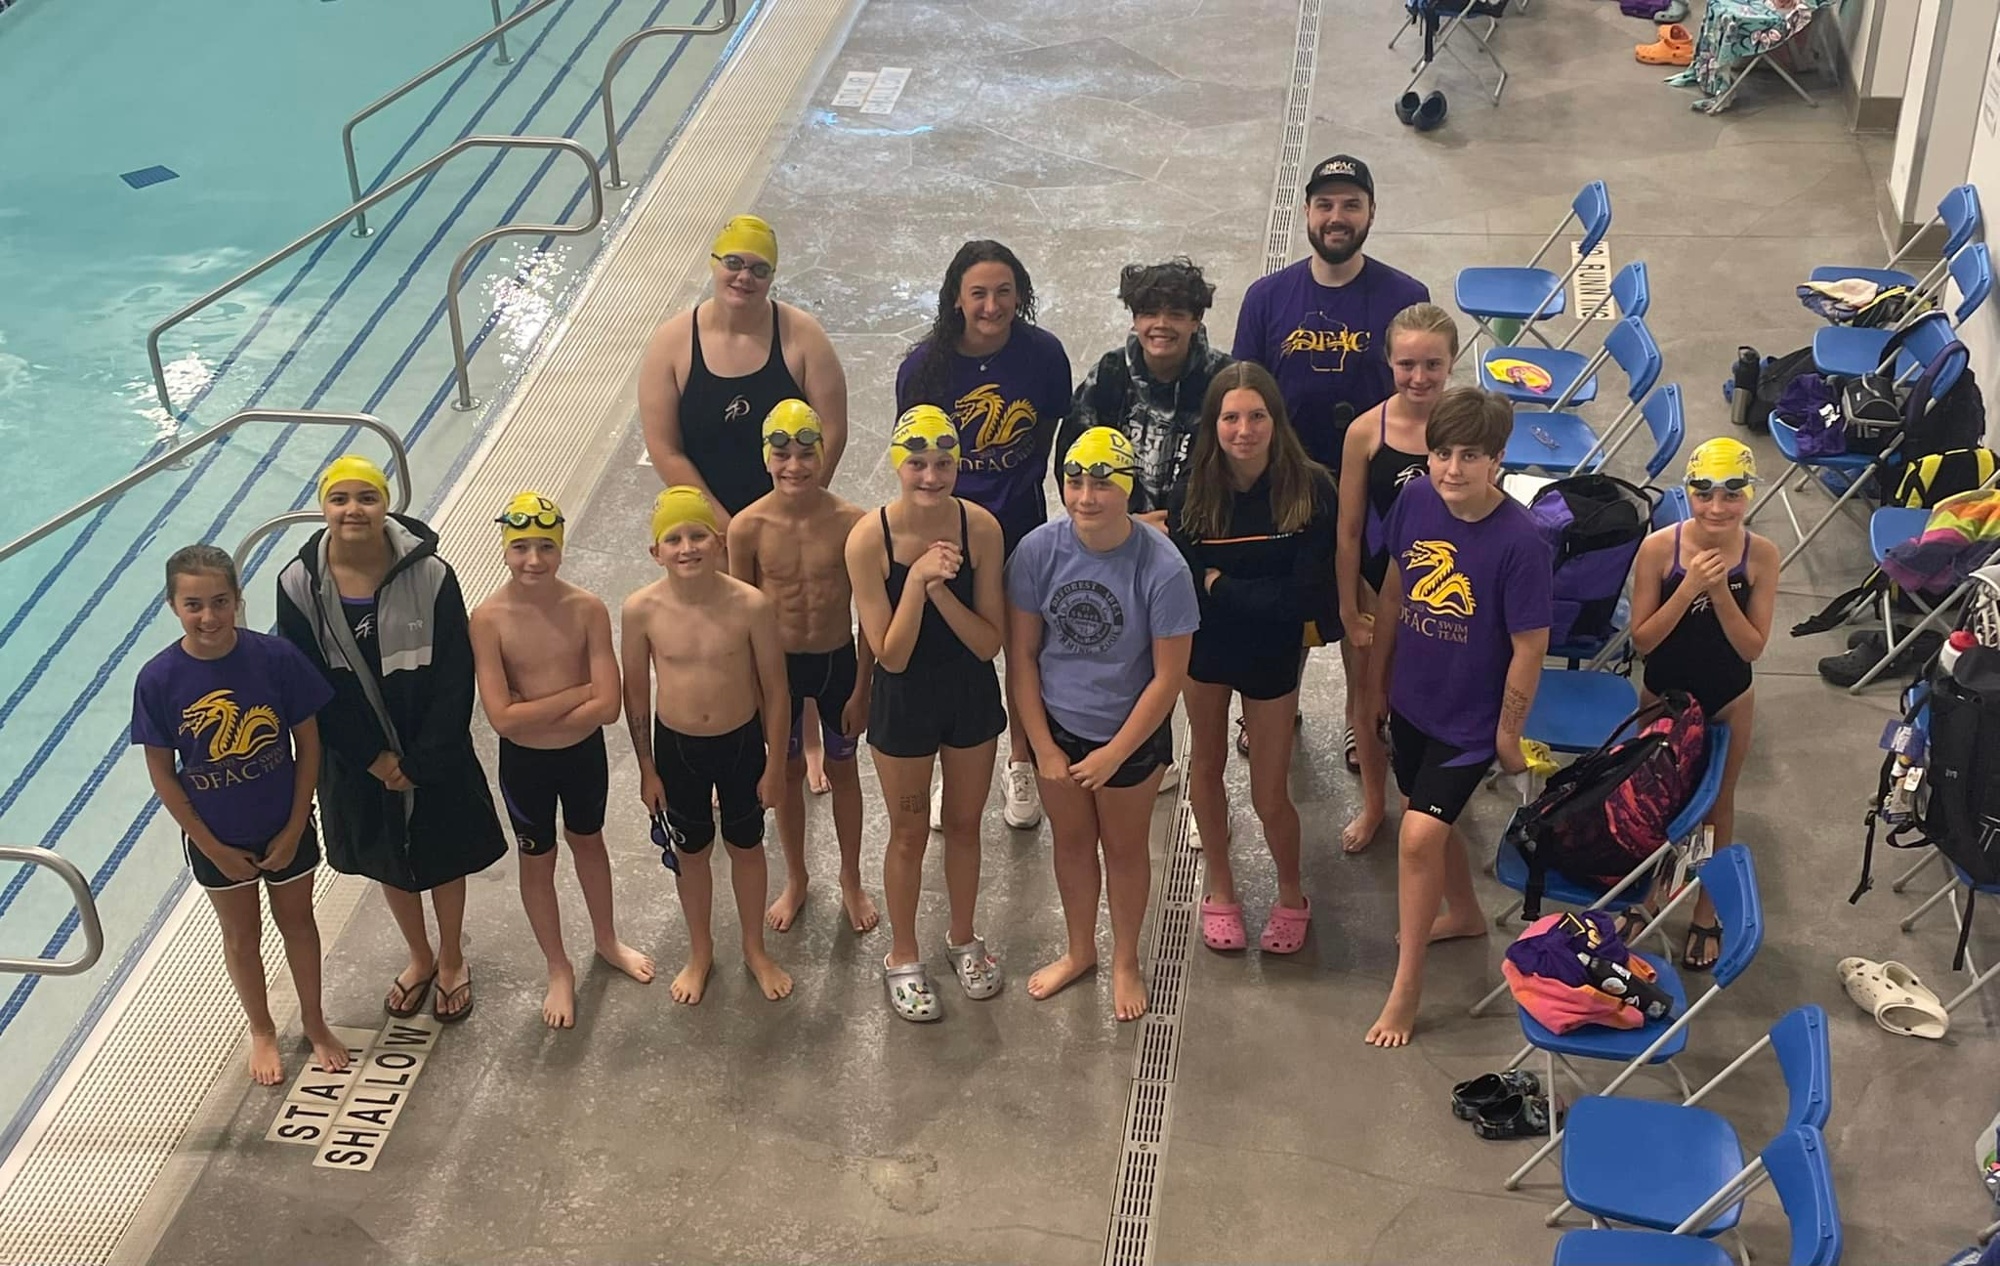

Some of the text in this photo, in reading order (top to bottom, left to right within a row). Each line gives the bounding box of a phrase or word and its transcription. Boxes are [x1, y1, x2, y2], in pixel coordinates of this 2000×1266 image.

[1437, 629, 1468, 644] TEAM
[1438, 620, 1469, 634] SWIM
[188, 761, 261, 790] DFAC
[277, 1048, 363, 1141] STAI
[324, 1025, 432, 1166] SHALLOW
